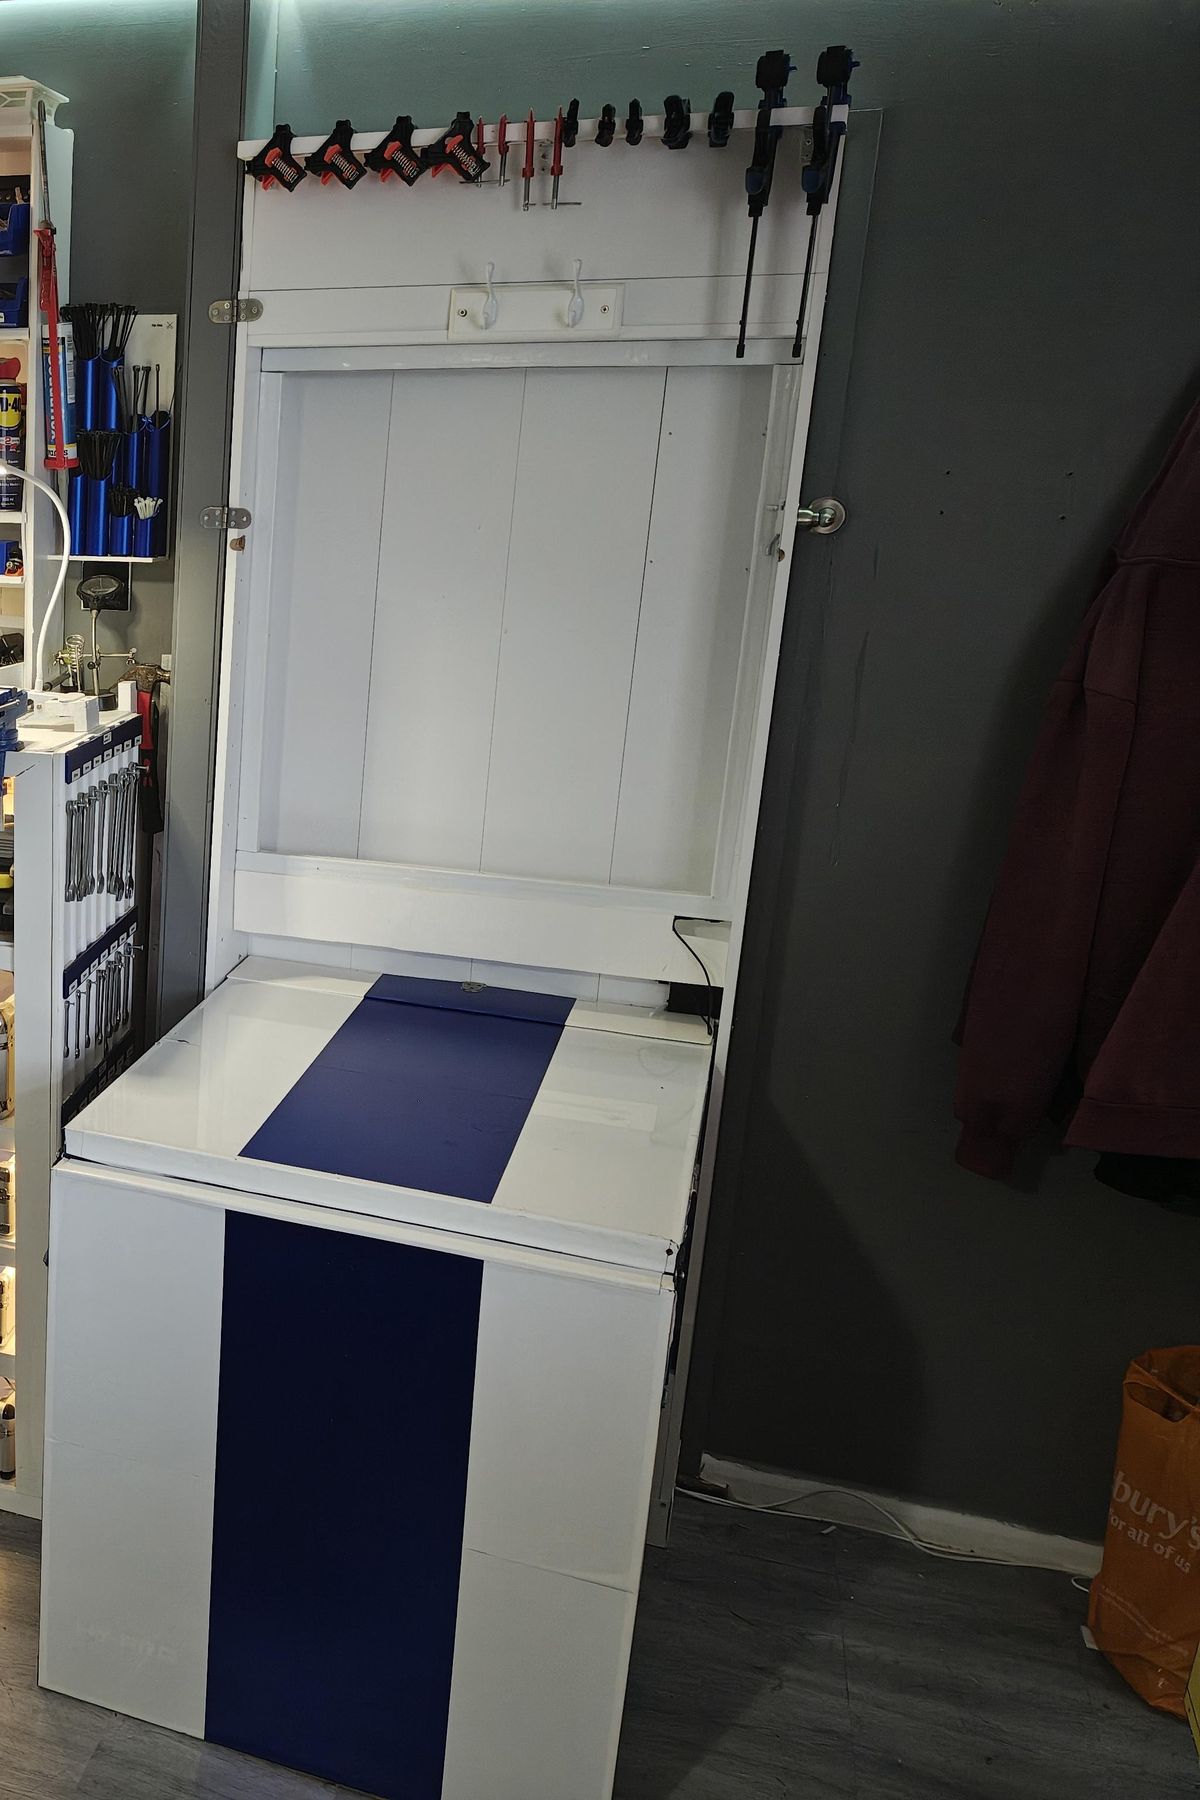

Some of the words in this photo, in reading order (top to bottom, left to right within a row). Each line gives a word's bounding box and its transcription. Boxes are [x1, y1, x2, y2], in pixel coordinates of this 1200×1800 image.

[1127, 1526, 1151, 1548] all
[1153, 1542, 1176, 1560] of
[1174, 1553, 1191, 1574] us
